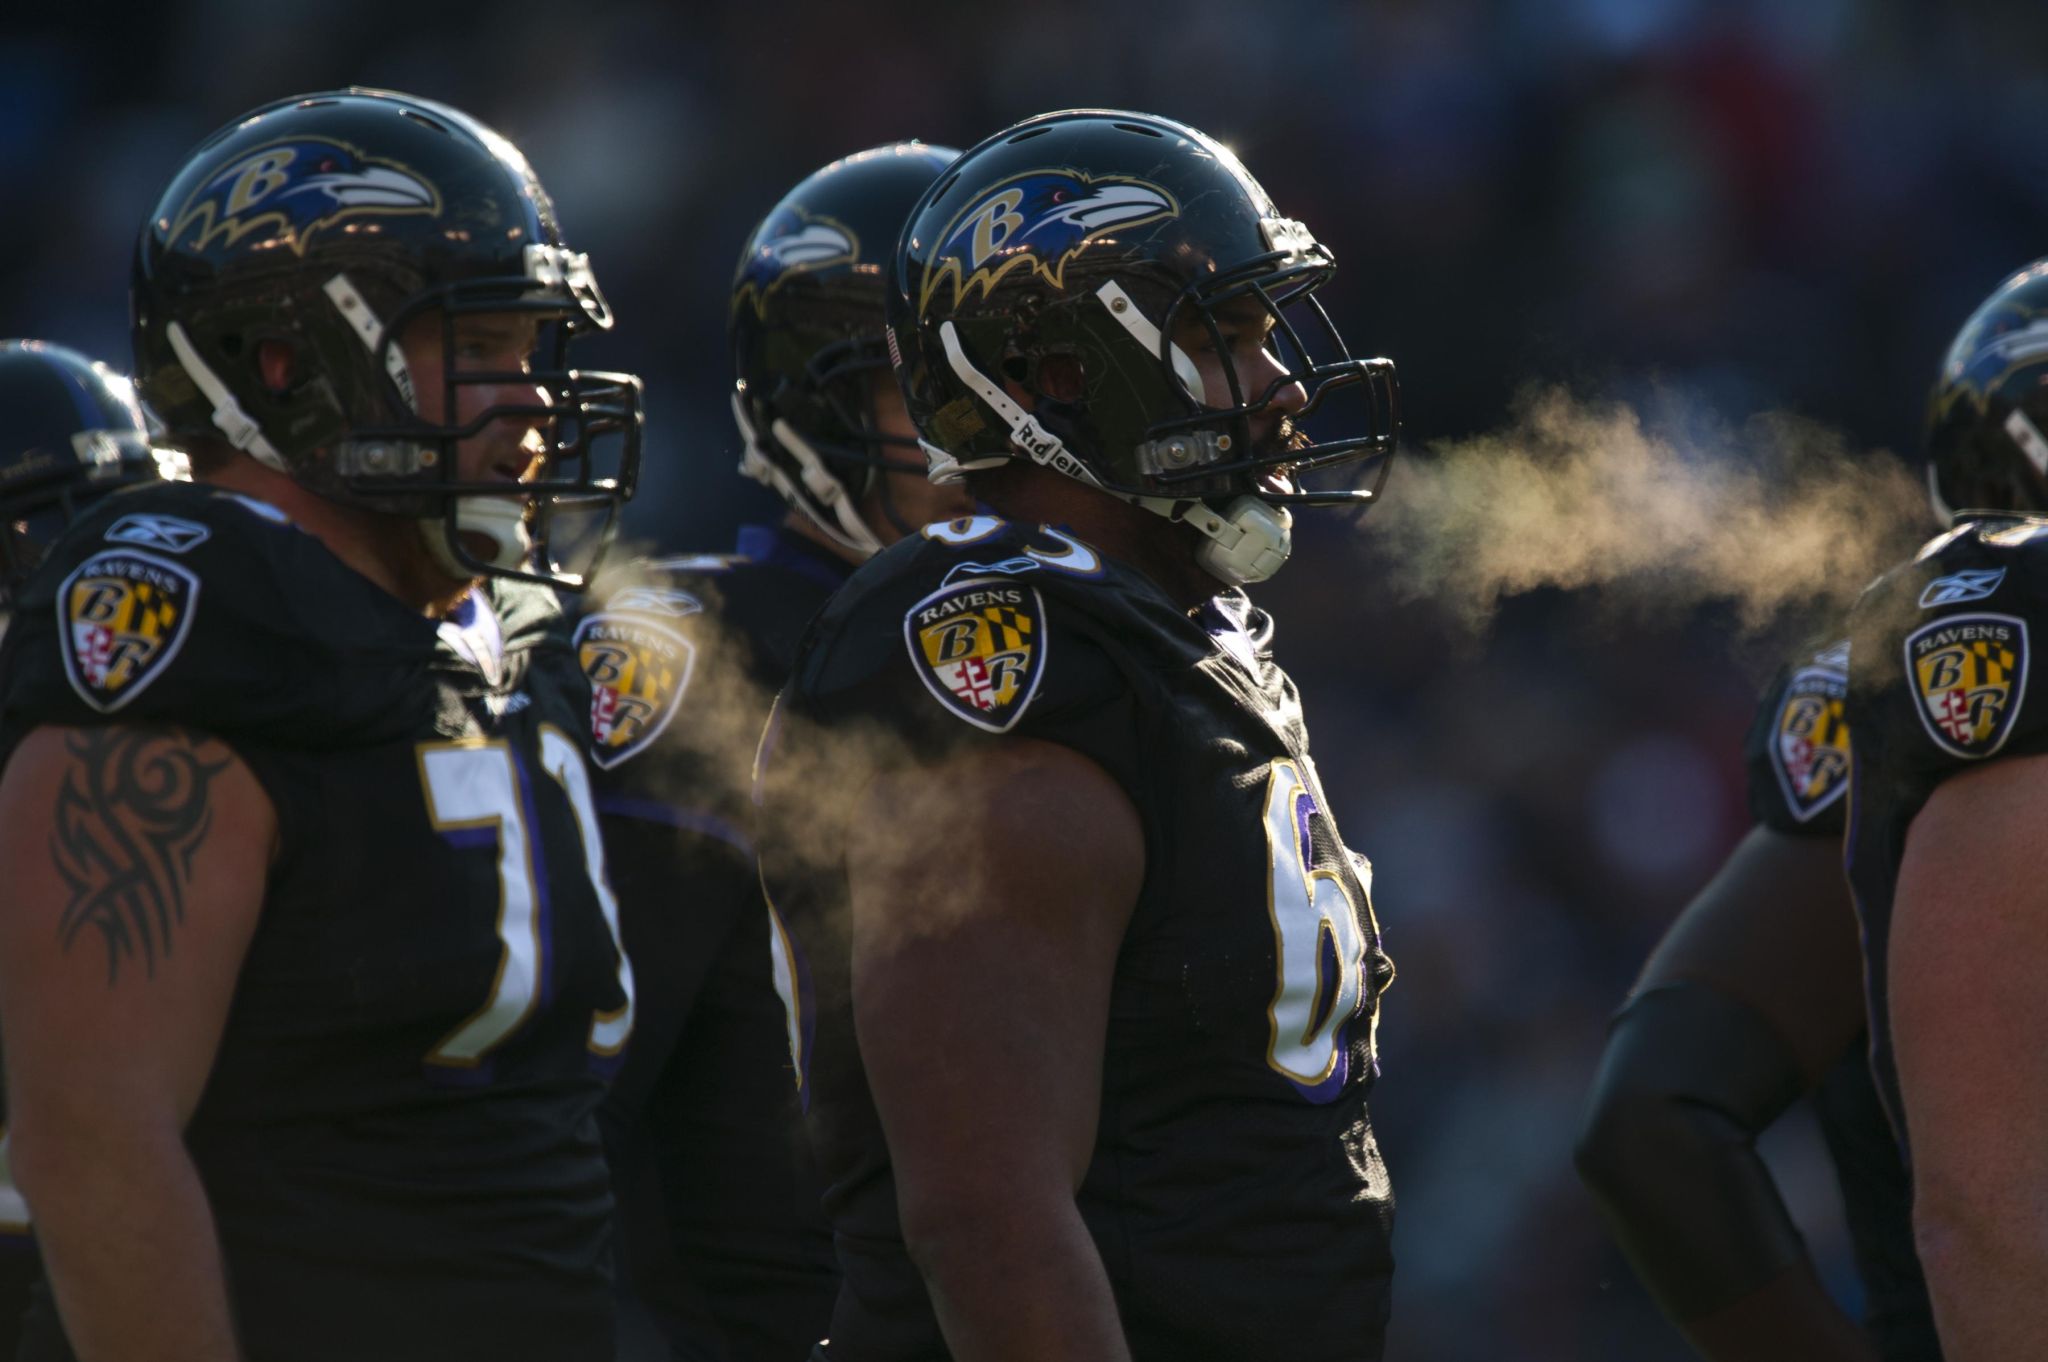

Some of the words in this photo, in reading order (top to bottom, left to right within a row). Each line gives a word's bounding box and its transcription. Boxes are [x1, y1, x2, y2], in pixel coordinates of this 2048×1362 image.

[946, 188, 1024, 270] B
[1019, 423, 1083, 477] Ridell
[918, 590, 1022, 625] RAVENS
[928, 618, 980, 662] B
[1917, 625, 2010, 654] RAVENS
[1926, 651, 1966, 690] B
[1262, 757, 1376, 1095] 6
